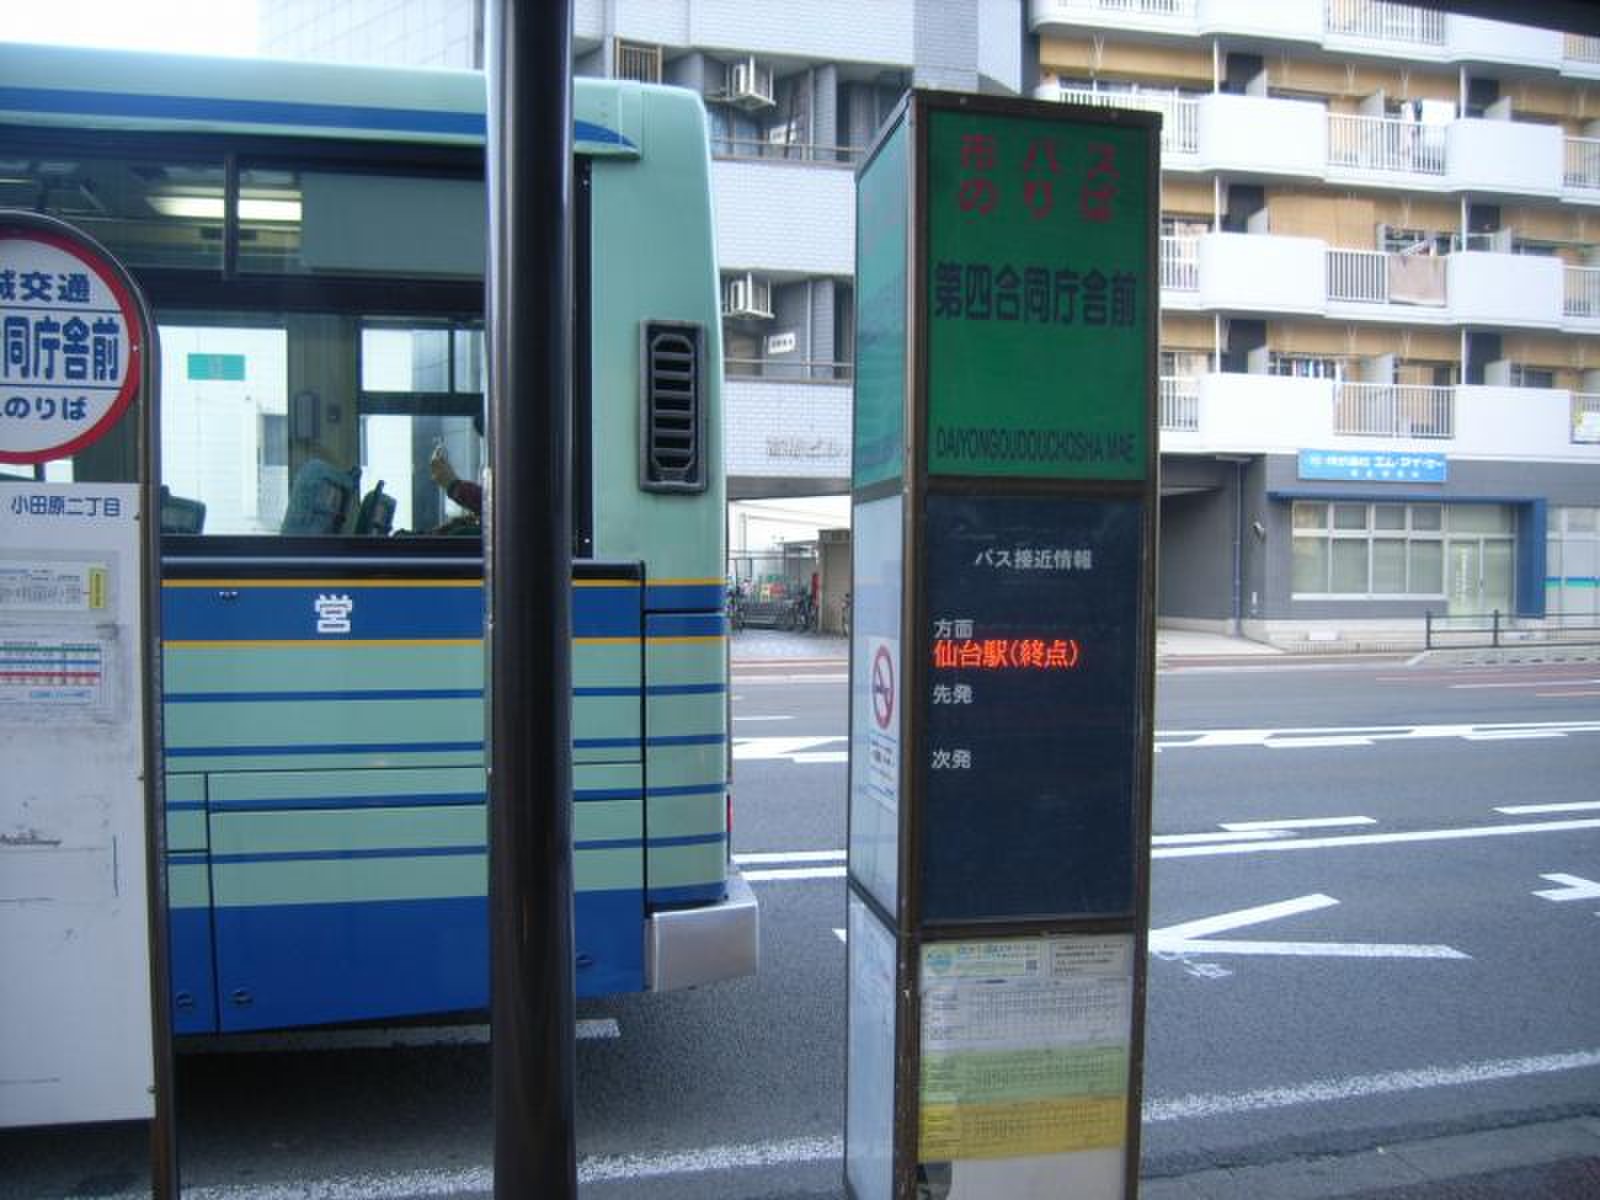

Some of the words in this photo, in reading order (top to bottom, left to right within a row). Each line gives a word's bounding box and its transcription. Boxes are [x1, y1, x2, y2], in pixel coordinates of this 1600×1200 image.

[935, 261, 1137, 327] 第四合同庁舎前
[4, 315, 120, 381] 同庁舎前
[0, 396, 87, 421] のりば
[11, 495, 120, 518] 小田原二丁目
[974, 548, 1093, 571] バス接近情報
[314, 594, 353, 633] 営
[933, 618, 974, 639] 方面
[933, 639, 1080, 669] 仙台駅(終点)
[933, 684, 973, 704] 先発
[931, 748, 972, 769] 次発
